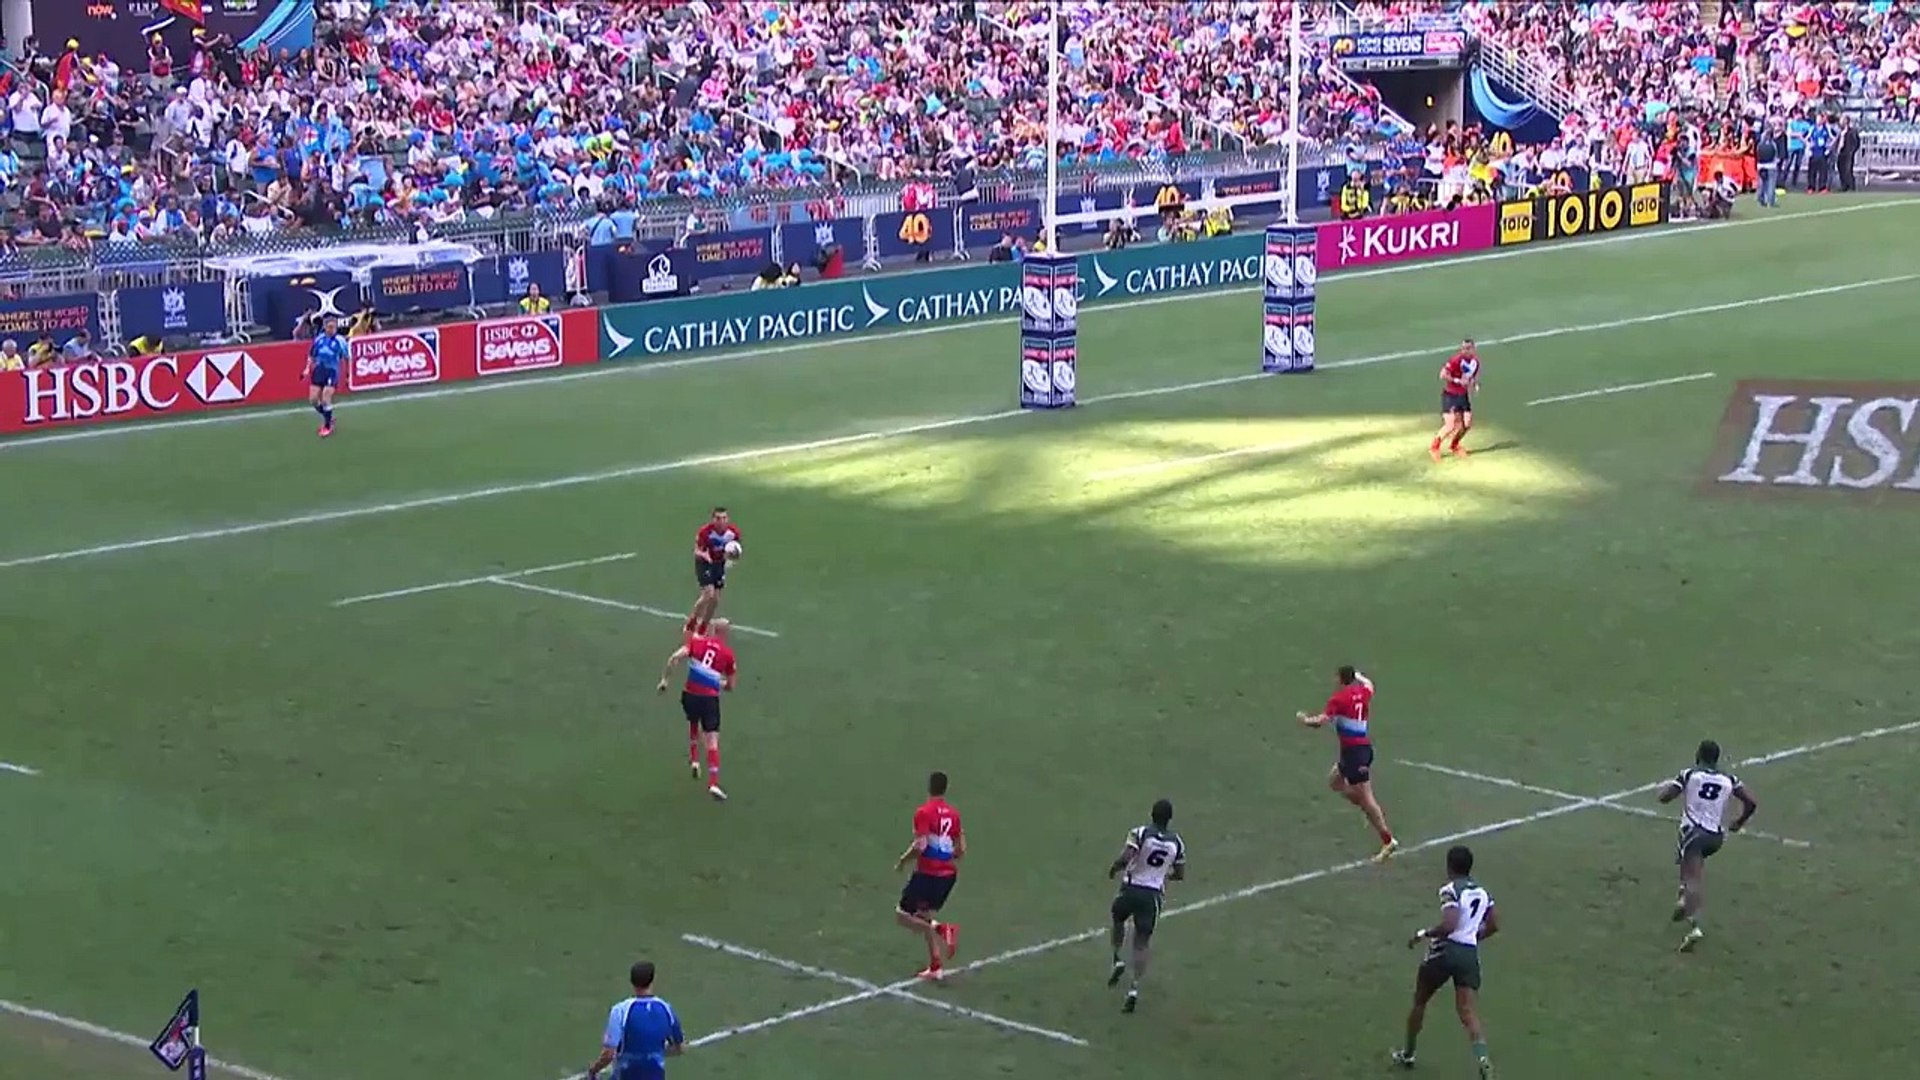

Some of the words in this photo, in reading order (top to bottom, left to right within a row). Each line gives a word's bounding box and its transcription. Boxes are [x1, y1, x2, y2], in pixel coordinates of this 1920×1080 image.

[897, 212, 933, 244] 40
[1364, 220, 1460, 257] KUKRI
[1126, 256, 1217, 294] CATHAY
[1219, 254, 1264, 281] PACI
[898, 288, 994, 324] CATHAY
[42, 319, 58, 332] TO
[60, 316, 88, 329] PLAY
[485, 325, 520, 342] HSBC
[643, 316, 752, 354] CATHAY
[758, 305, 855, 340] PACIFIC
[356, 339, 394, 357] HSBC
[22, 357, 180, 424] HSBC
[1717, 394, 1920, 489] HS
[1698, 782, 1722, 800] 8
[1146, 849, 1169, 867] 6
